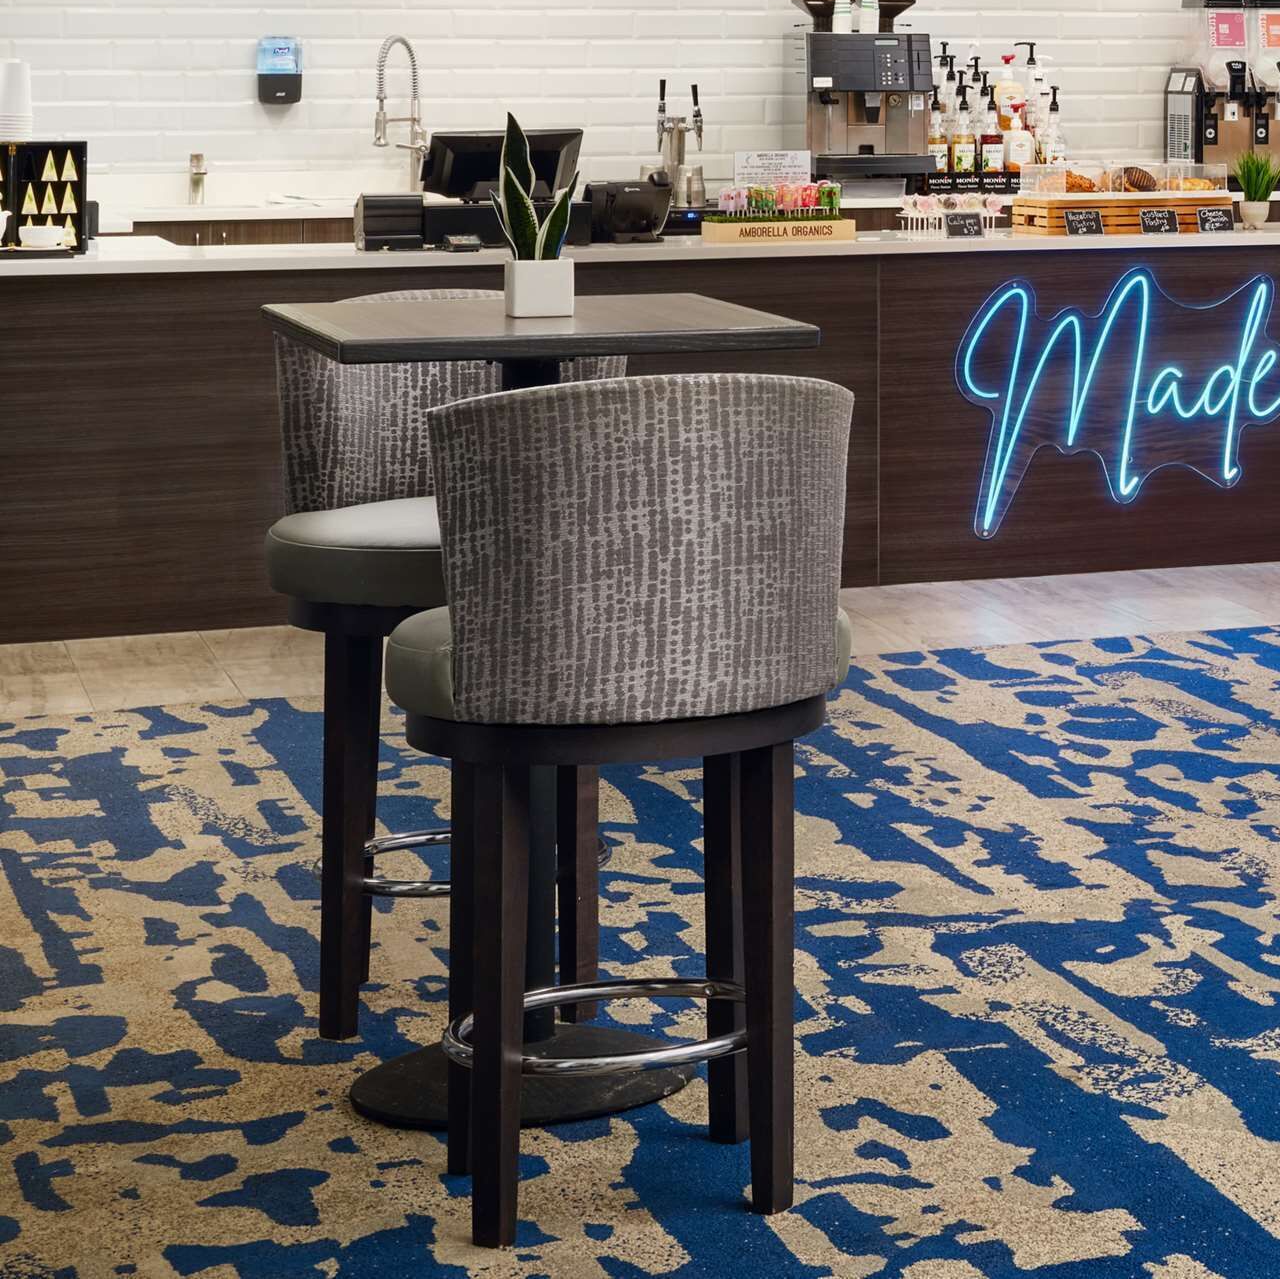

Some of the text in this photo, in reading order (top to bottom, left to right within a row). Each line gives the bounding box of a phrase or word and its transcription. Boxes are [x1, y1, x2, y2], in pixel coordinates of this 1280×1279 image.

[929, 176, 953, 185] MONIN
[956, 175, 980, 184] MONIN
[983, 176, 1007, 184] MONIN
[1141, 210, 1168, 218] Custard
[1201, 209, 1223, 217] Cheese
[1073, 220, 1096, 230] Pastry
[1145, 217, 1167, 226] Pastry
[739, 225, 833, 238] AMBORELLA ORGANICS
